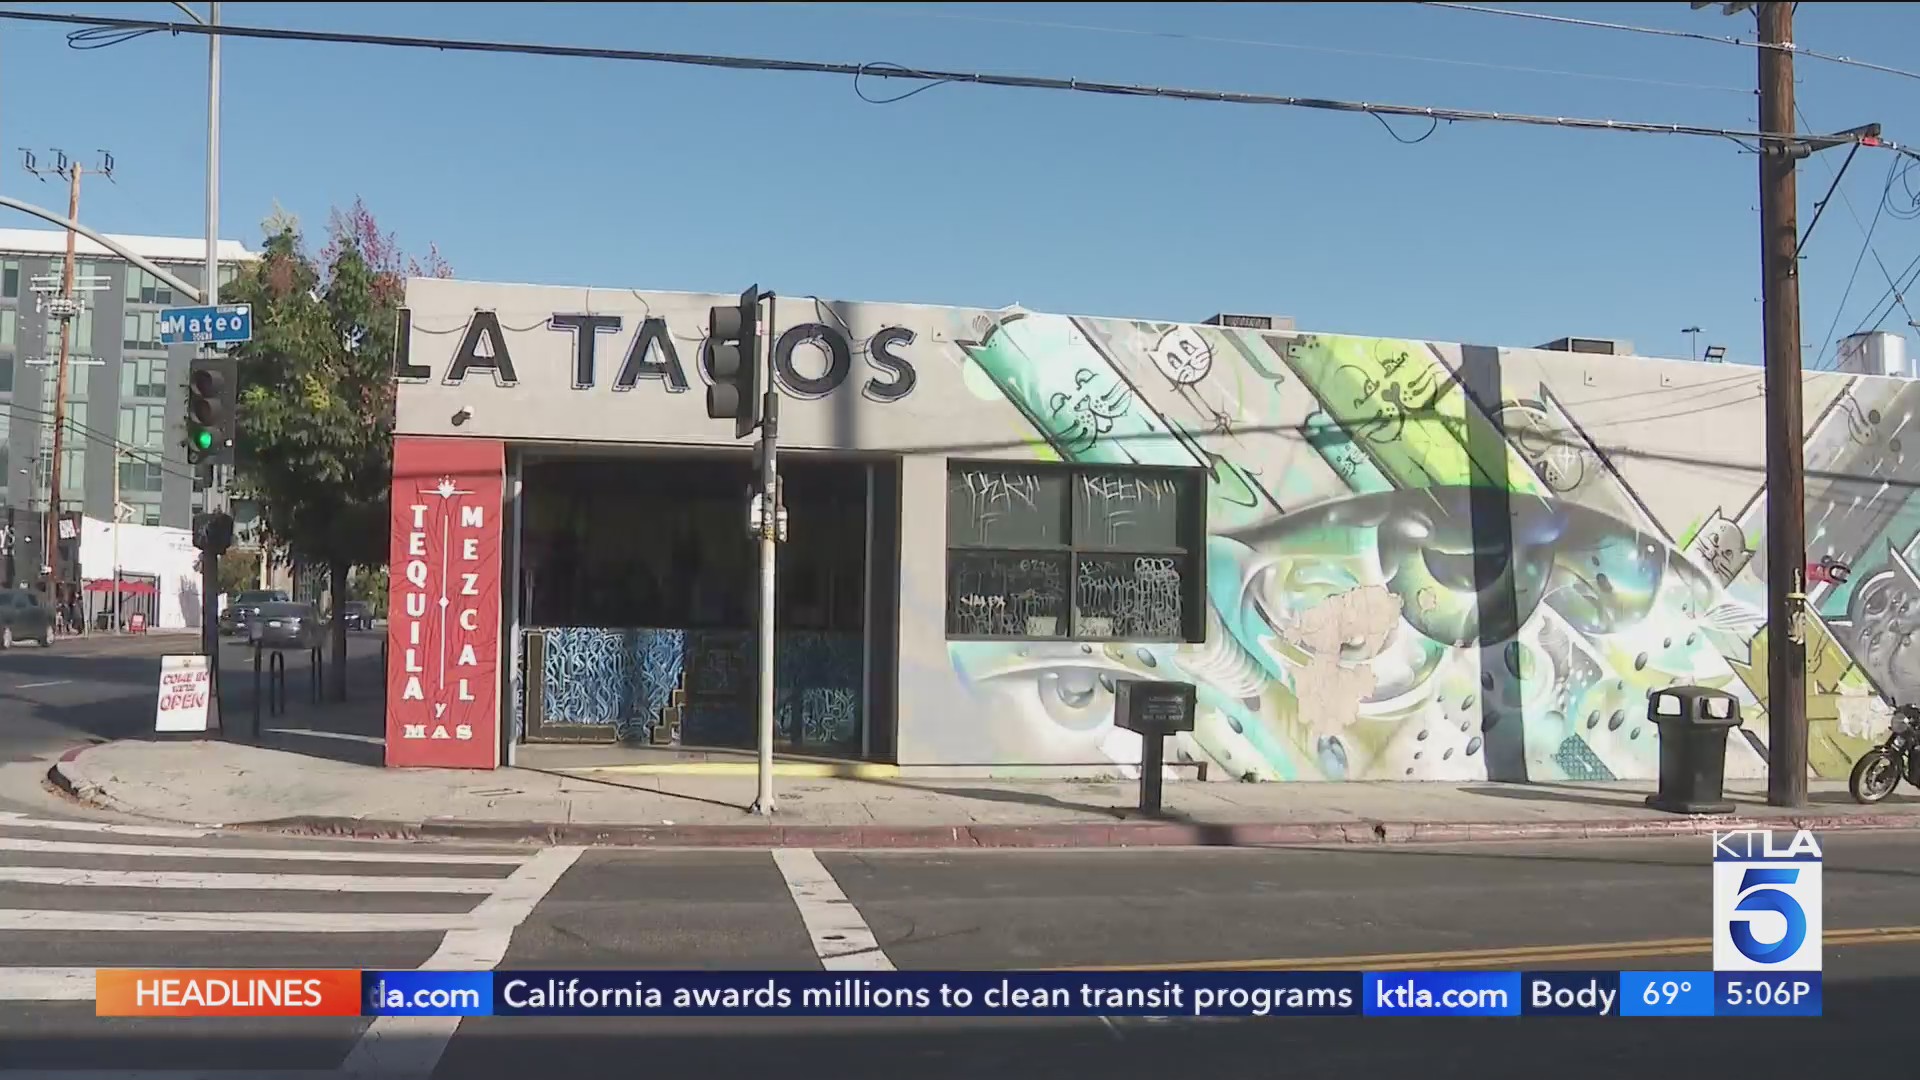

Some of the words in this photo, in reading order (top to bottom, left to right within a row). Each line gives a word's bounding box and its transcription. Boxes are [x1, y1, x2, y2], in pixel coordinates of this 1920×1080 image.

[168, 313, 243, 334] Mateo
[394, 306, 520, 387] LA
[402, 504, 428, 701] TEQUILA
[458, 505, 484, 701] MEZCAL
[160, 692, 205, 711] OPEN
[403, 724, 473, 739] MAS
